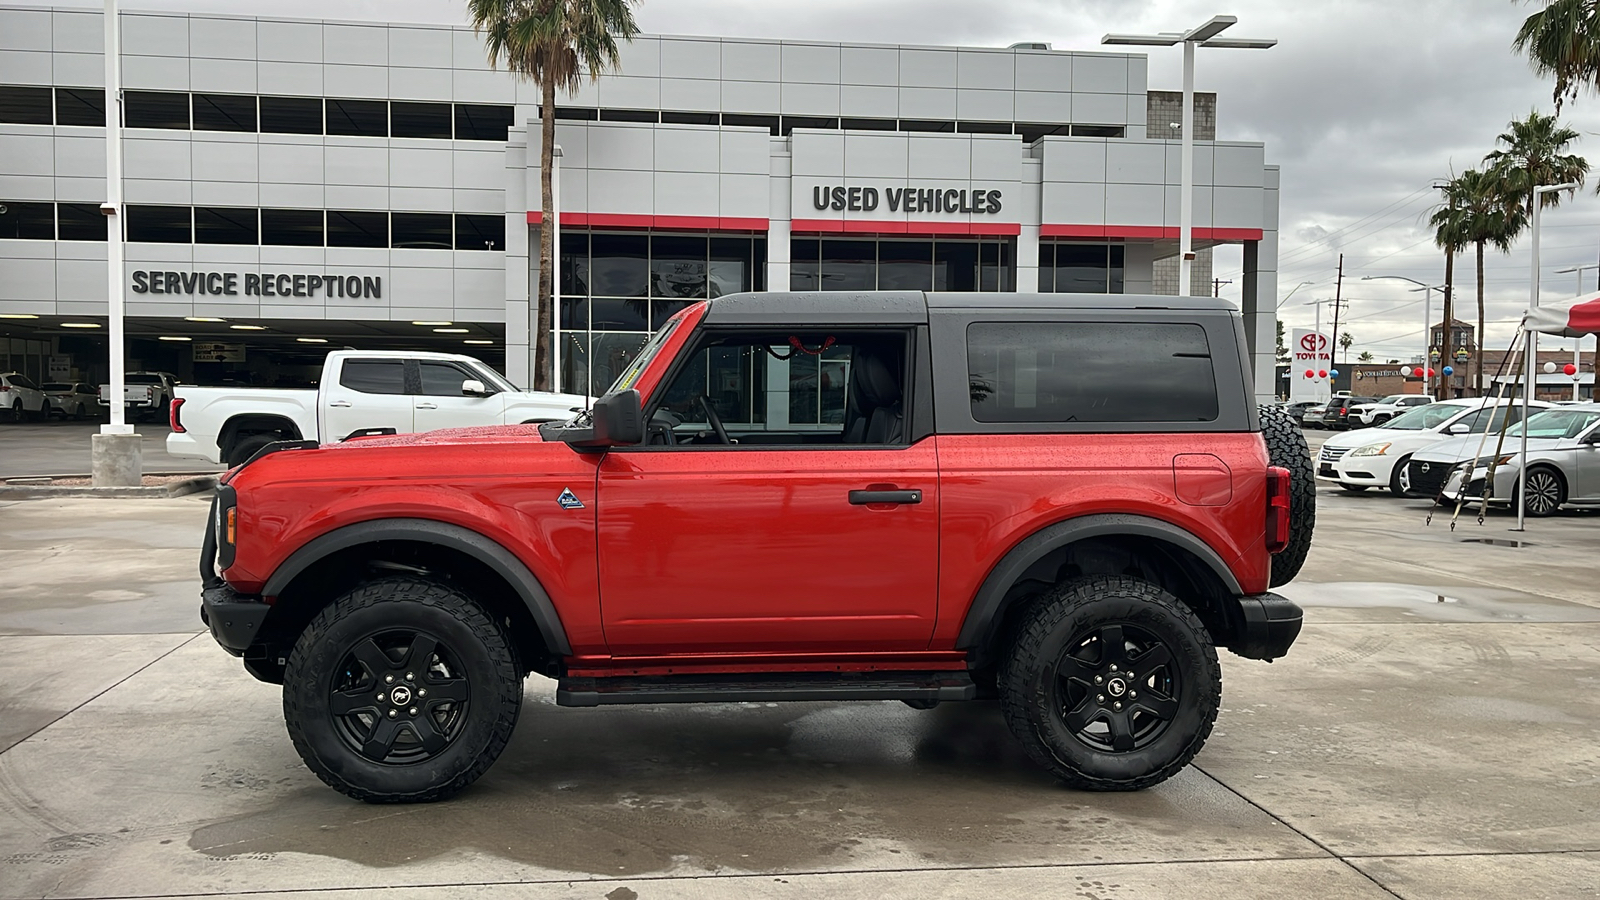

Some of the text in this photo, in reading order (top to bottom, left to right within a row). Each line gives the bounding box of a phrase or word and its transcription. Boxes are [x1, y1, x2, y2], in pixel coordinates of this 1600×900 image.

[813, 186, 1002, 213] USED VEHICLES
[132, 271, 381, 298] SERVICE RECEPTION
